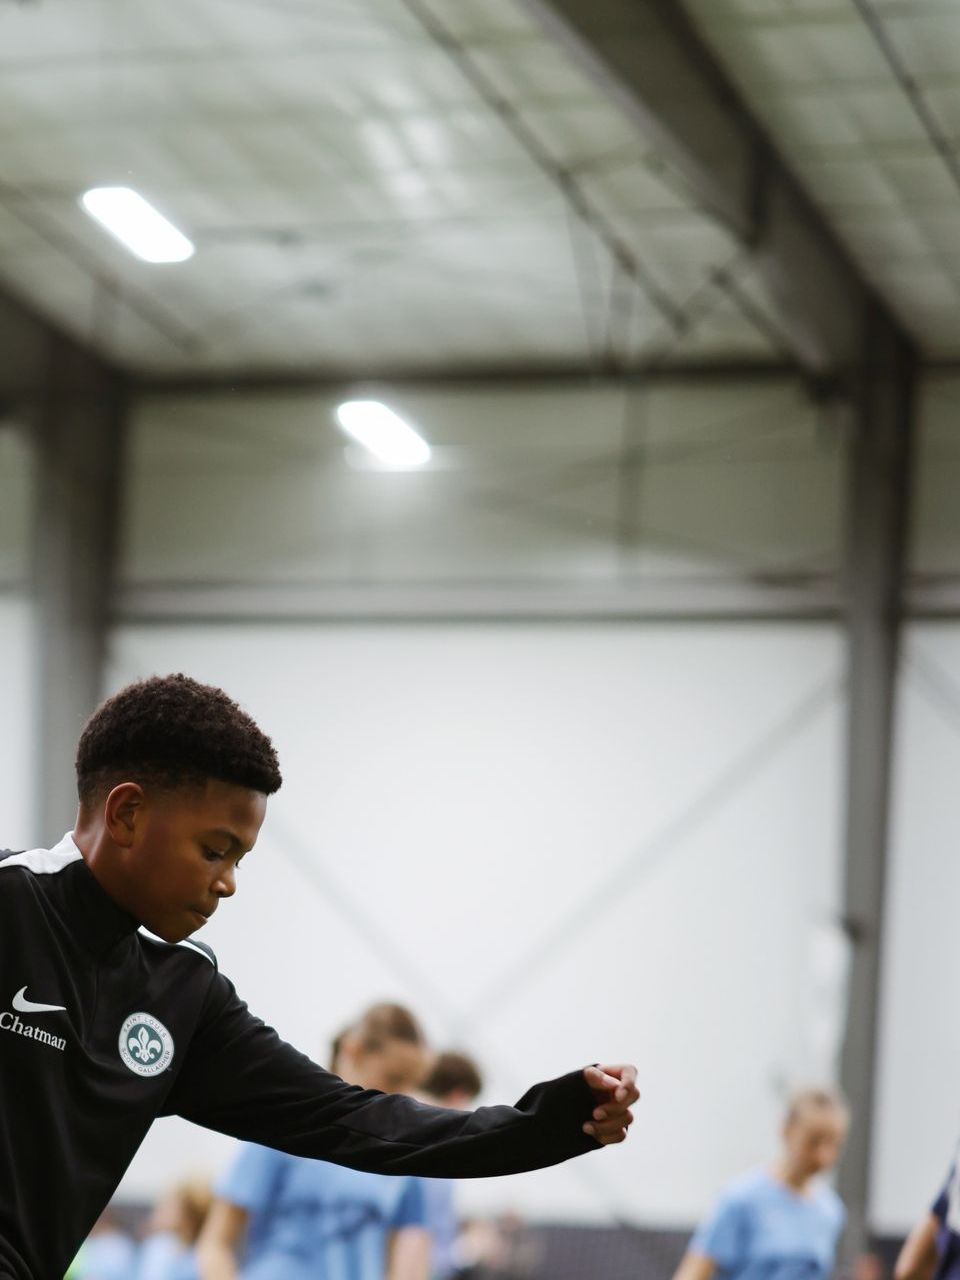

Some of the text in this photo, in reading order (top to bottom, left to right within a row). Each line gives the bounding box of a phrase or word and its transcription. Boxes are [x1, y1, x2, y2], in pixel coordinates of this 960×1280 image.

[123, 1015, 167, 1039] SAINT LOUIS
[121, 1048, 171, 1074] SCOTT GALLAGHER
